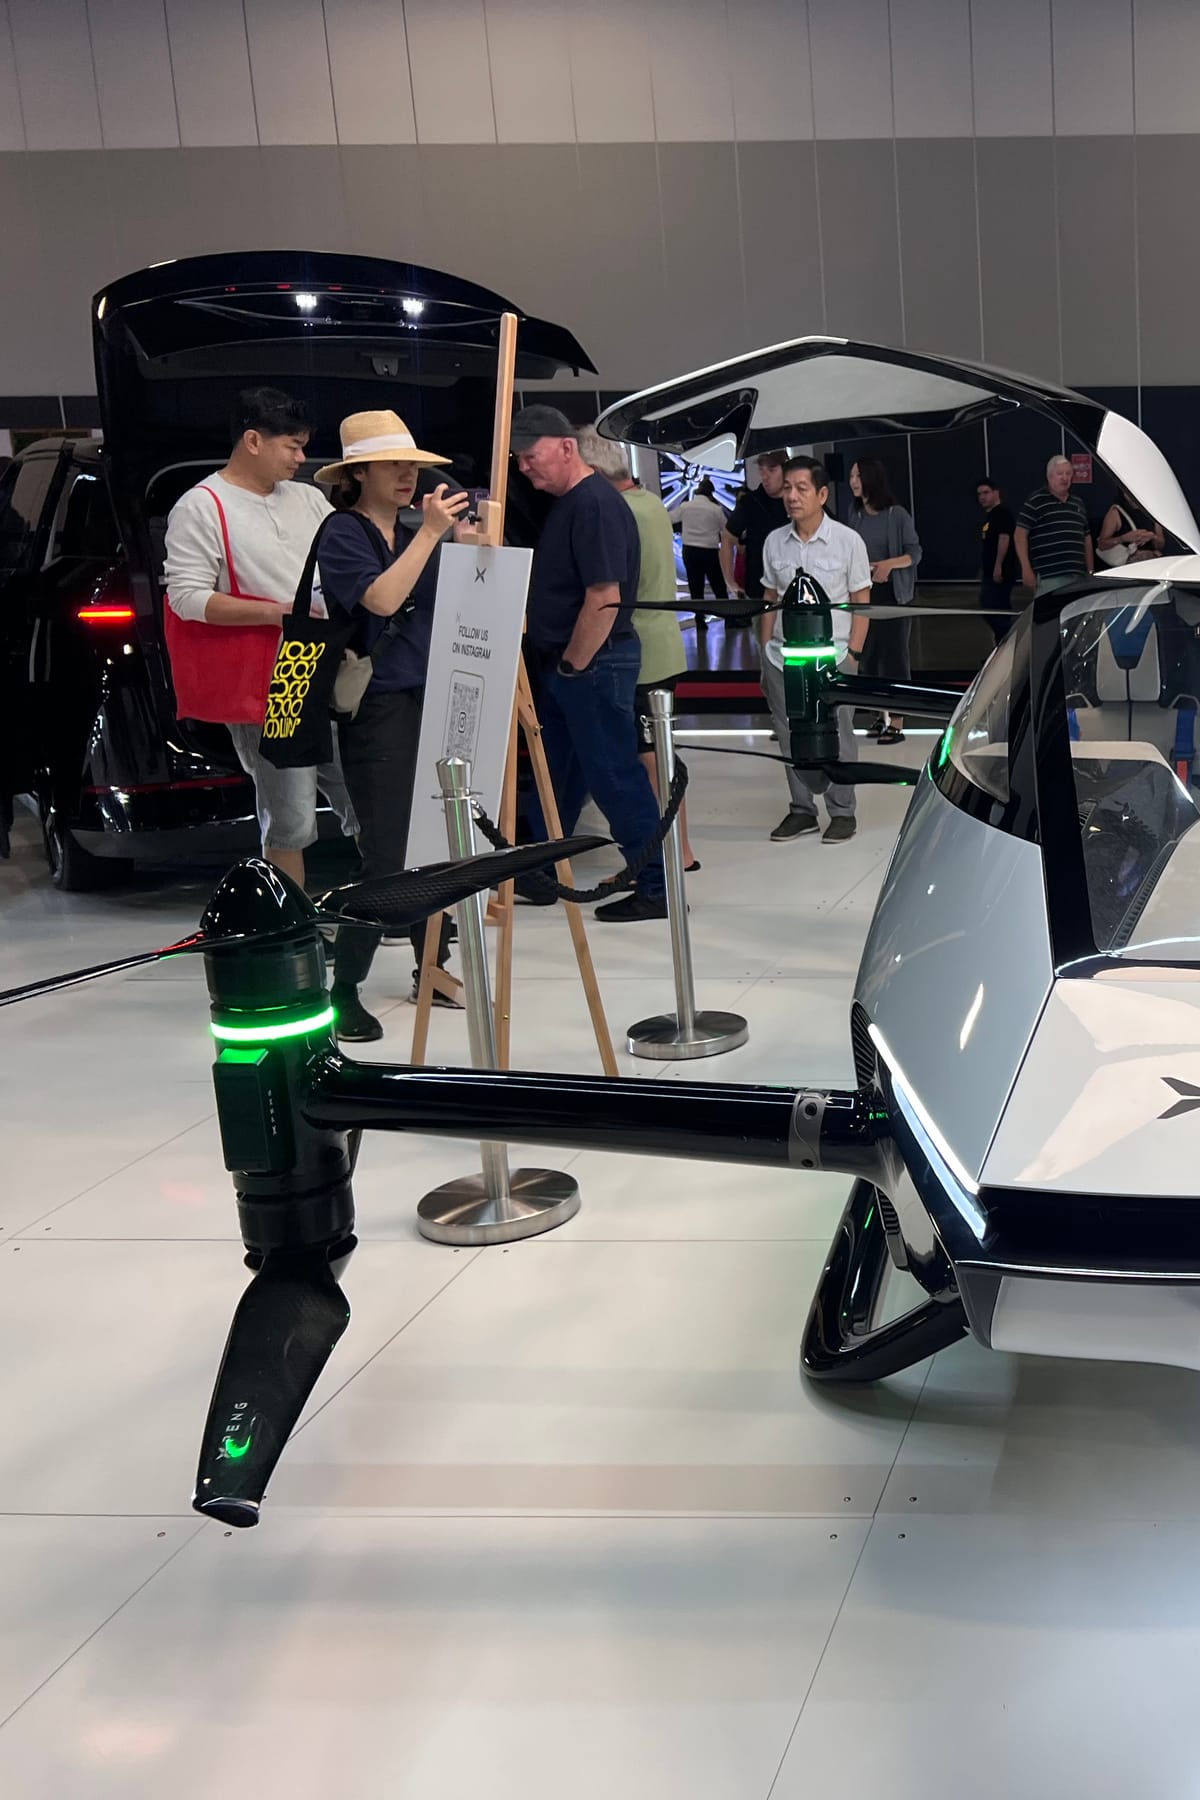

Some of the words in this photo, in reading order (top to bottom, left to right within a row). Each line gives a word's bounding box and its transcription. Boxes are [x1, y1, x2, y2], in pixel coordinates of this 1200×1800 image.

[457, 625, 480, 640] FOLLOW
[480, 629, 488, 641] US
[451, 641, 460, 653] ON
[460, 644, 491, 659] INSTAGRAM
